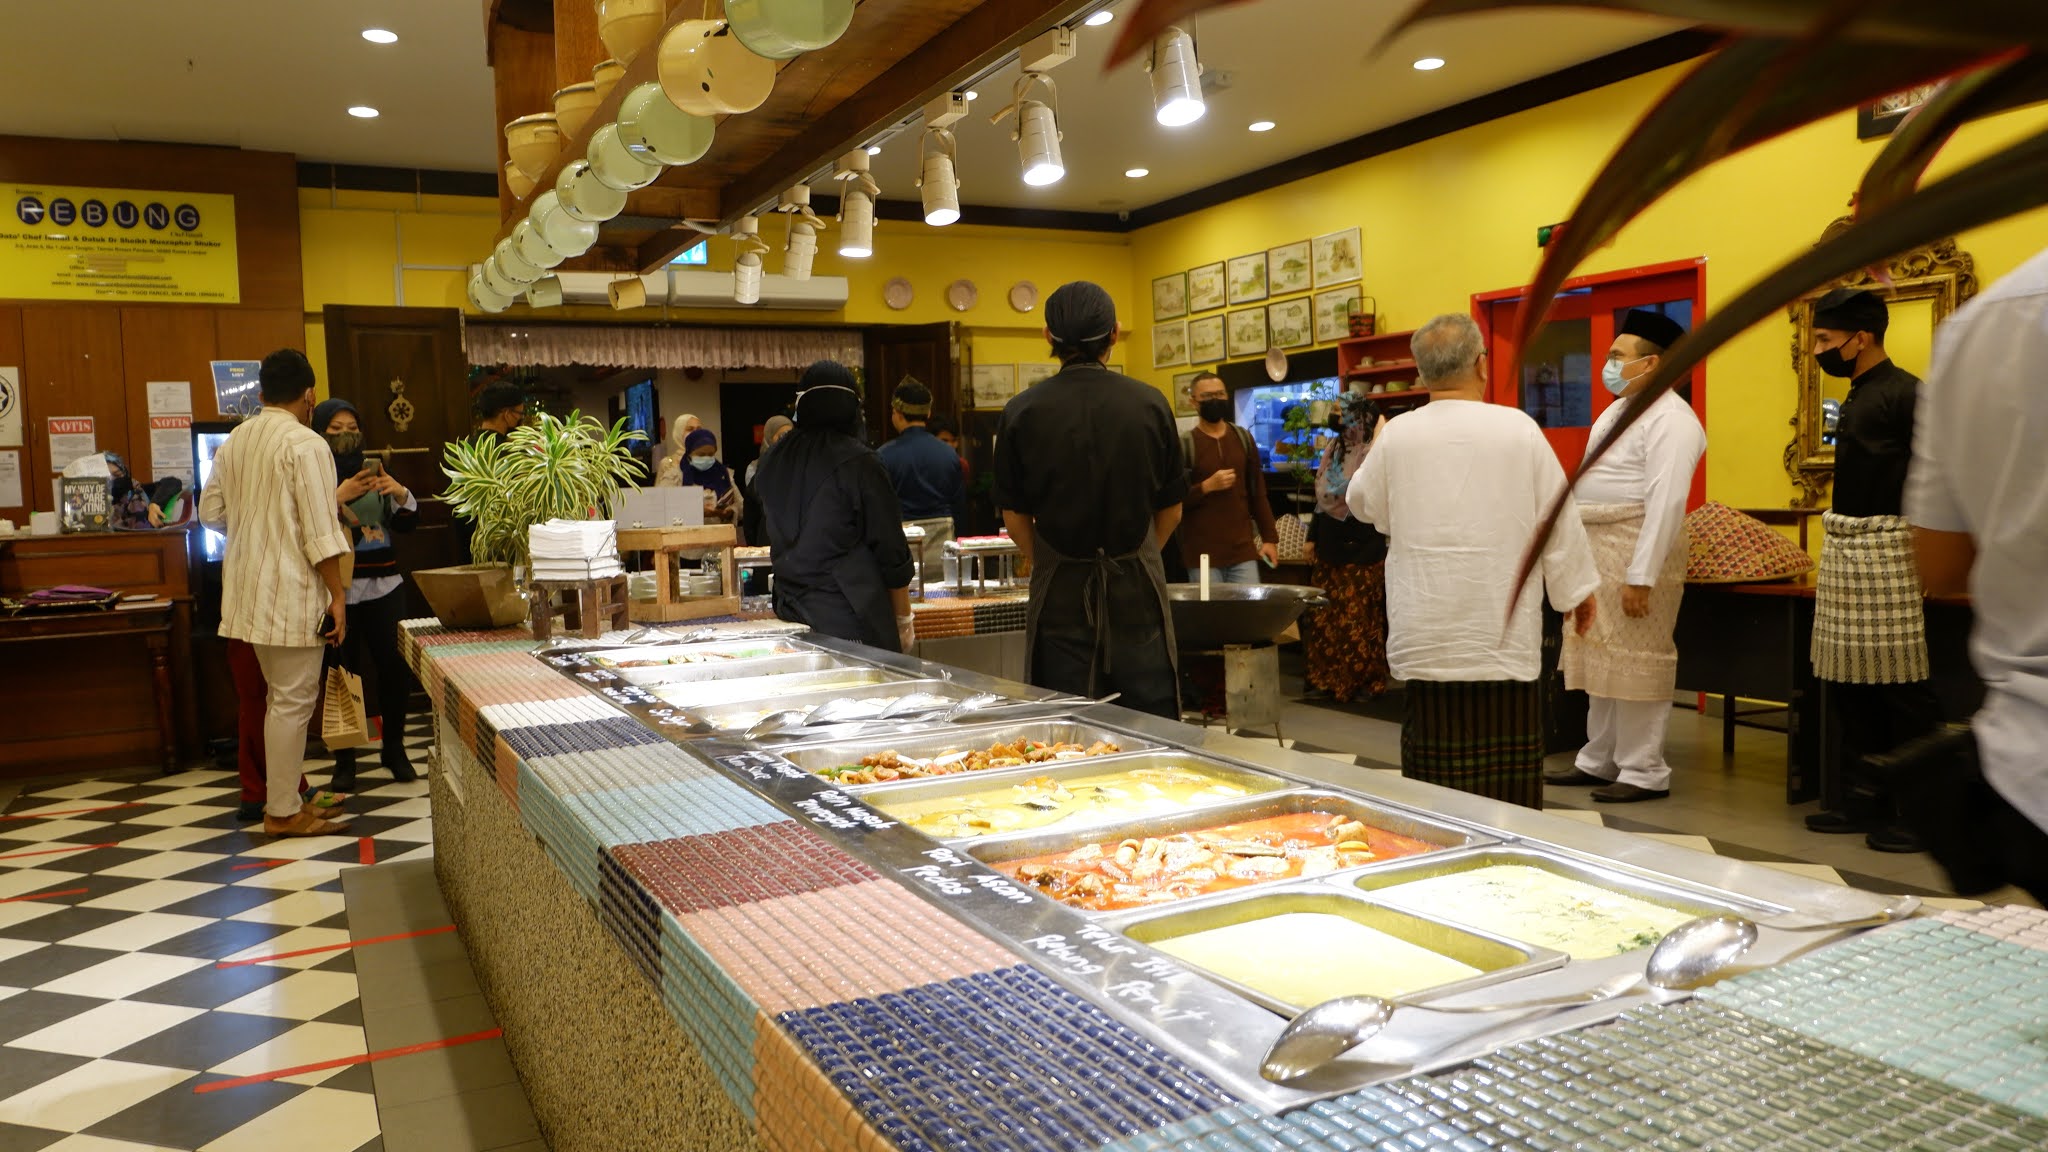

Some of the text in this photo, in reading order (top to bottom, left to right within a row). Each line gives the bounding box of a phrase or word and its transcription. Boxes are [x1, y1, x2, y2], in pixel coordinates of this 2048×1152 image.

[19, 199, 198, 229] REBUNG
[52, 421, 91, 432] NOTIS
[153, 418, 190, 428] NOTIS
[64, 485, 76, 494] MY
[77, 484, 95, 493] WAY
[95, 483, 106, 493] OF
[83, 492, 106, 504] PARE
[902, 864, 972, 895] Pedas
[921, 847, 1033, 904] Pari Asam
[1076, 923, 1137, 955] Telur
[1022, 934, 1104, 975] Rebung
